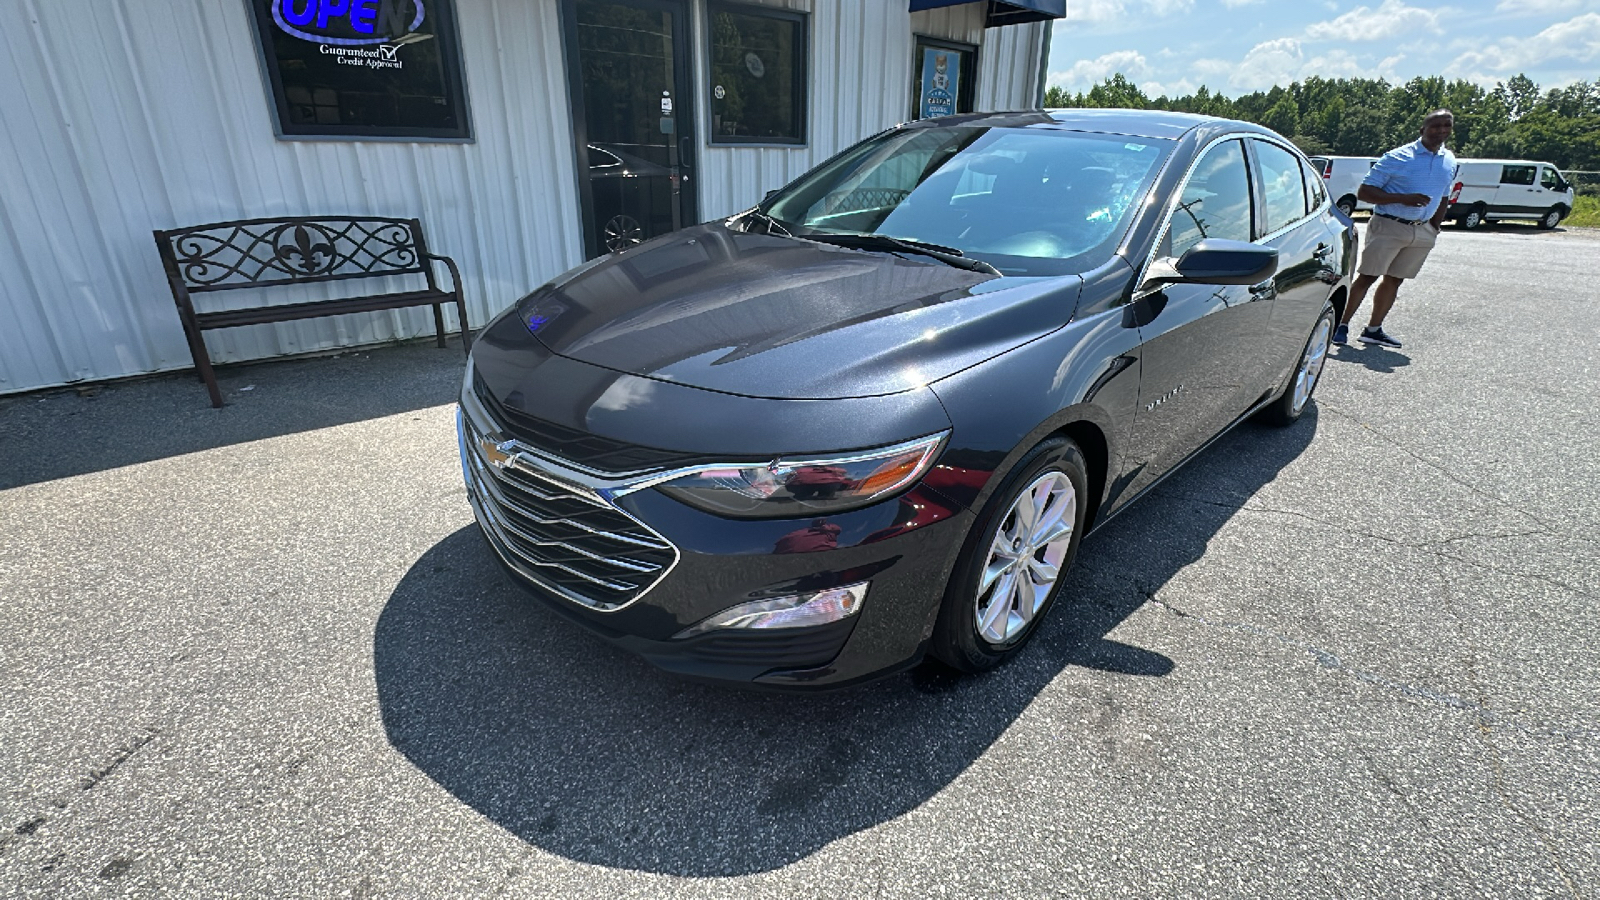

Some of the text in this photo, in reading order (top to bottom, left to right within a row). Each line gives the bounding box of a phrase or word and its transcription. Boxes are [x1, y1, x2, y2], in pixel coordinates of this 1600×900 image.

[282, 0, 408, 37] OPEN
[320, 44, 380, 58] Guaranteed
[337, 56, 402, 69] Credit Approval
